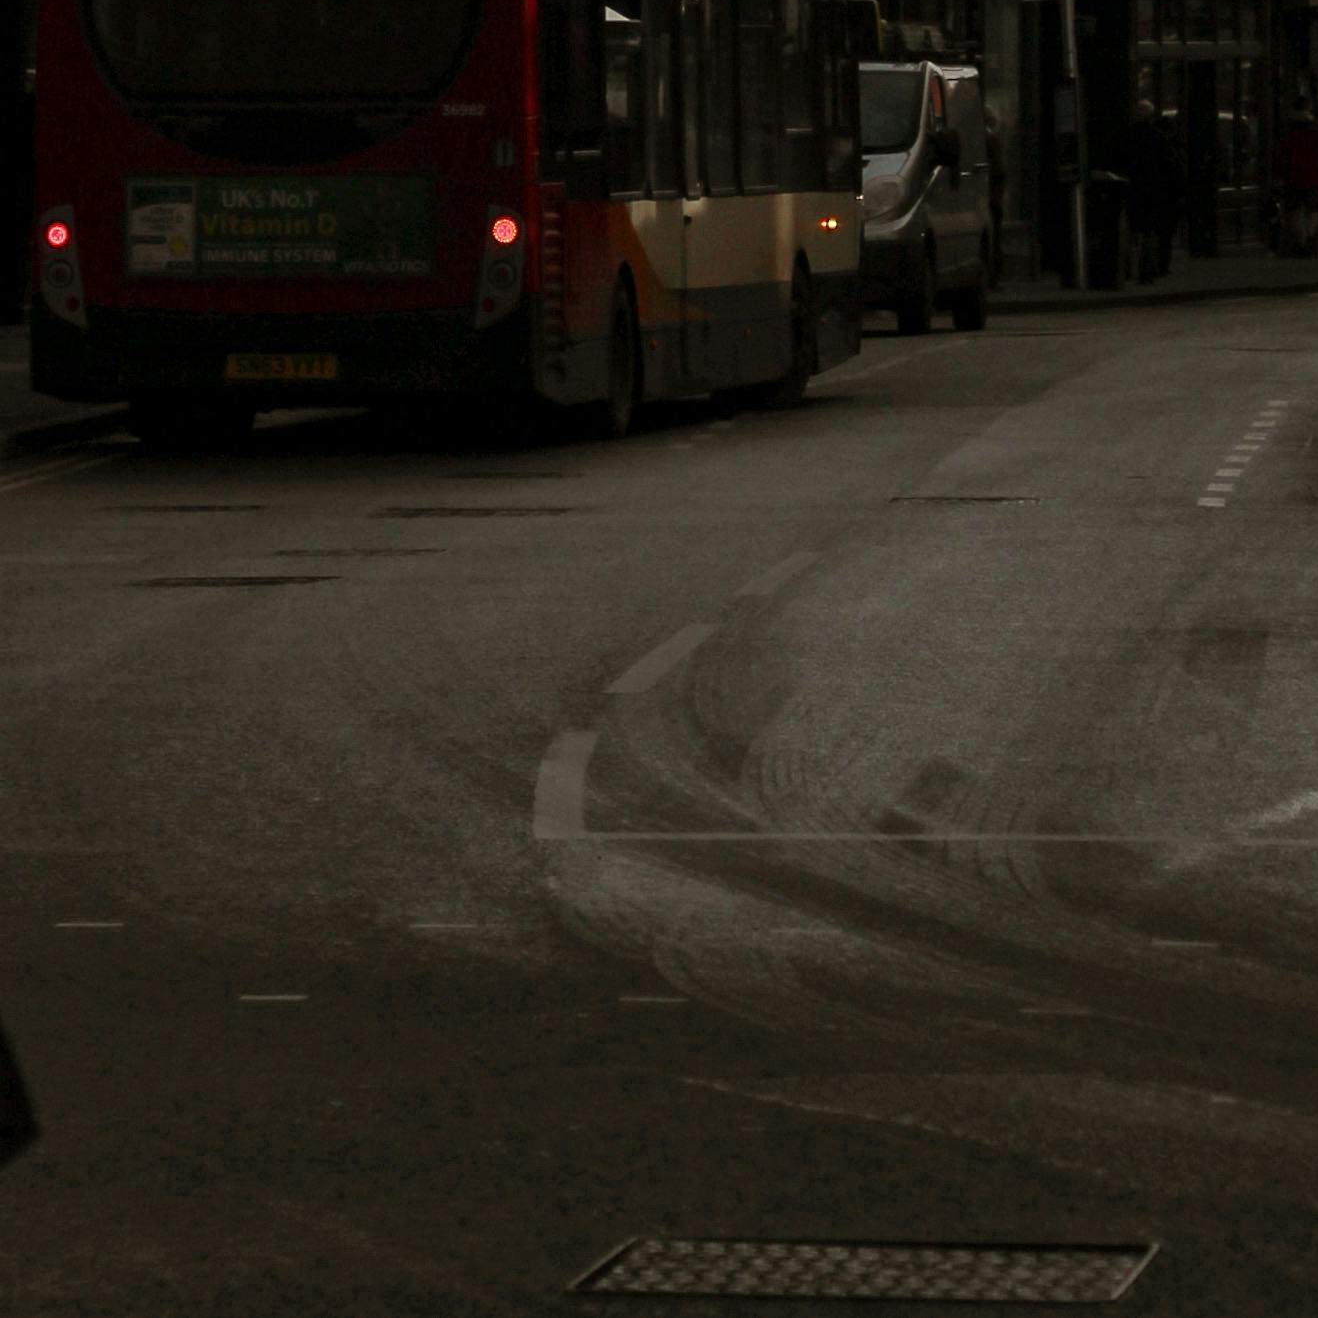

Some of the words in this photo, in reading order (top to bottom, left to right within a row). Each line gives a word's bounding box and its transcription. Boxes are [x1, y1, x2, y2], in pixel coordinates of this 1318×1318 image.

[201, 212, 312, 236] Vitamin
[316, 212, 337, 235] D
[201, 248, 269, 263] IMMUNE
[272, 248, 338, 263] SYSTEM
